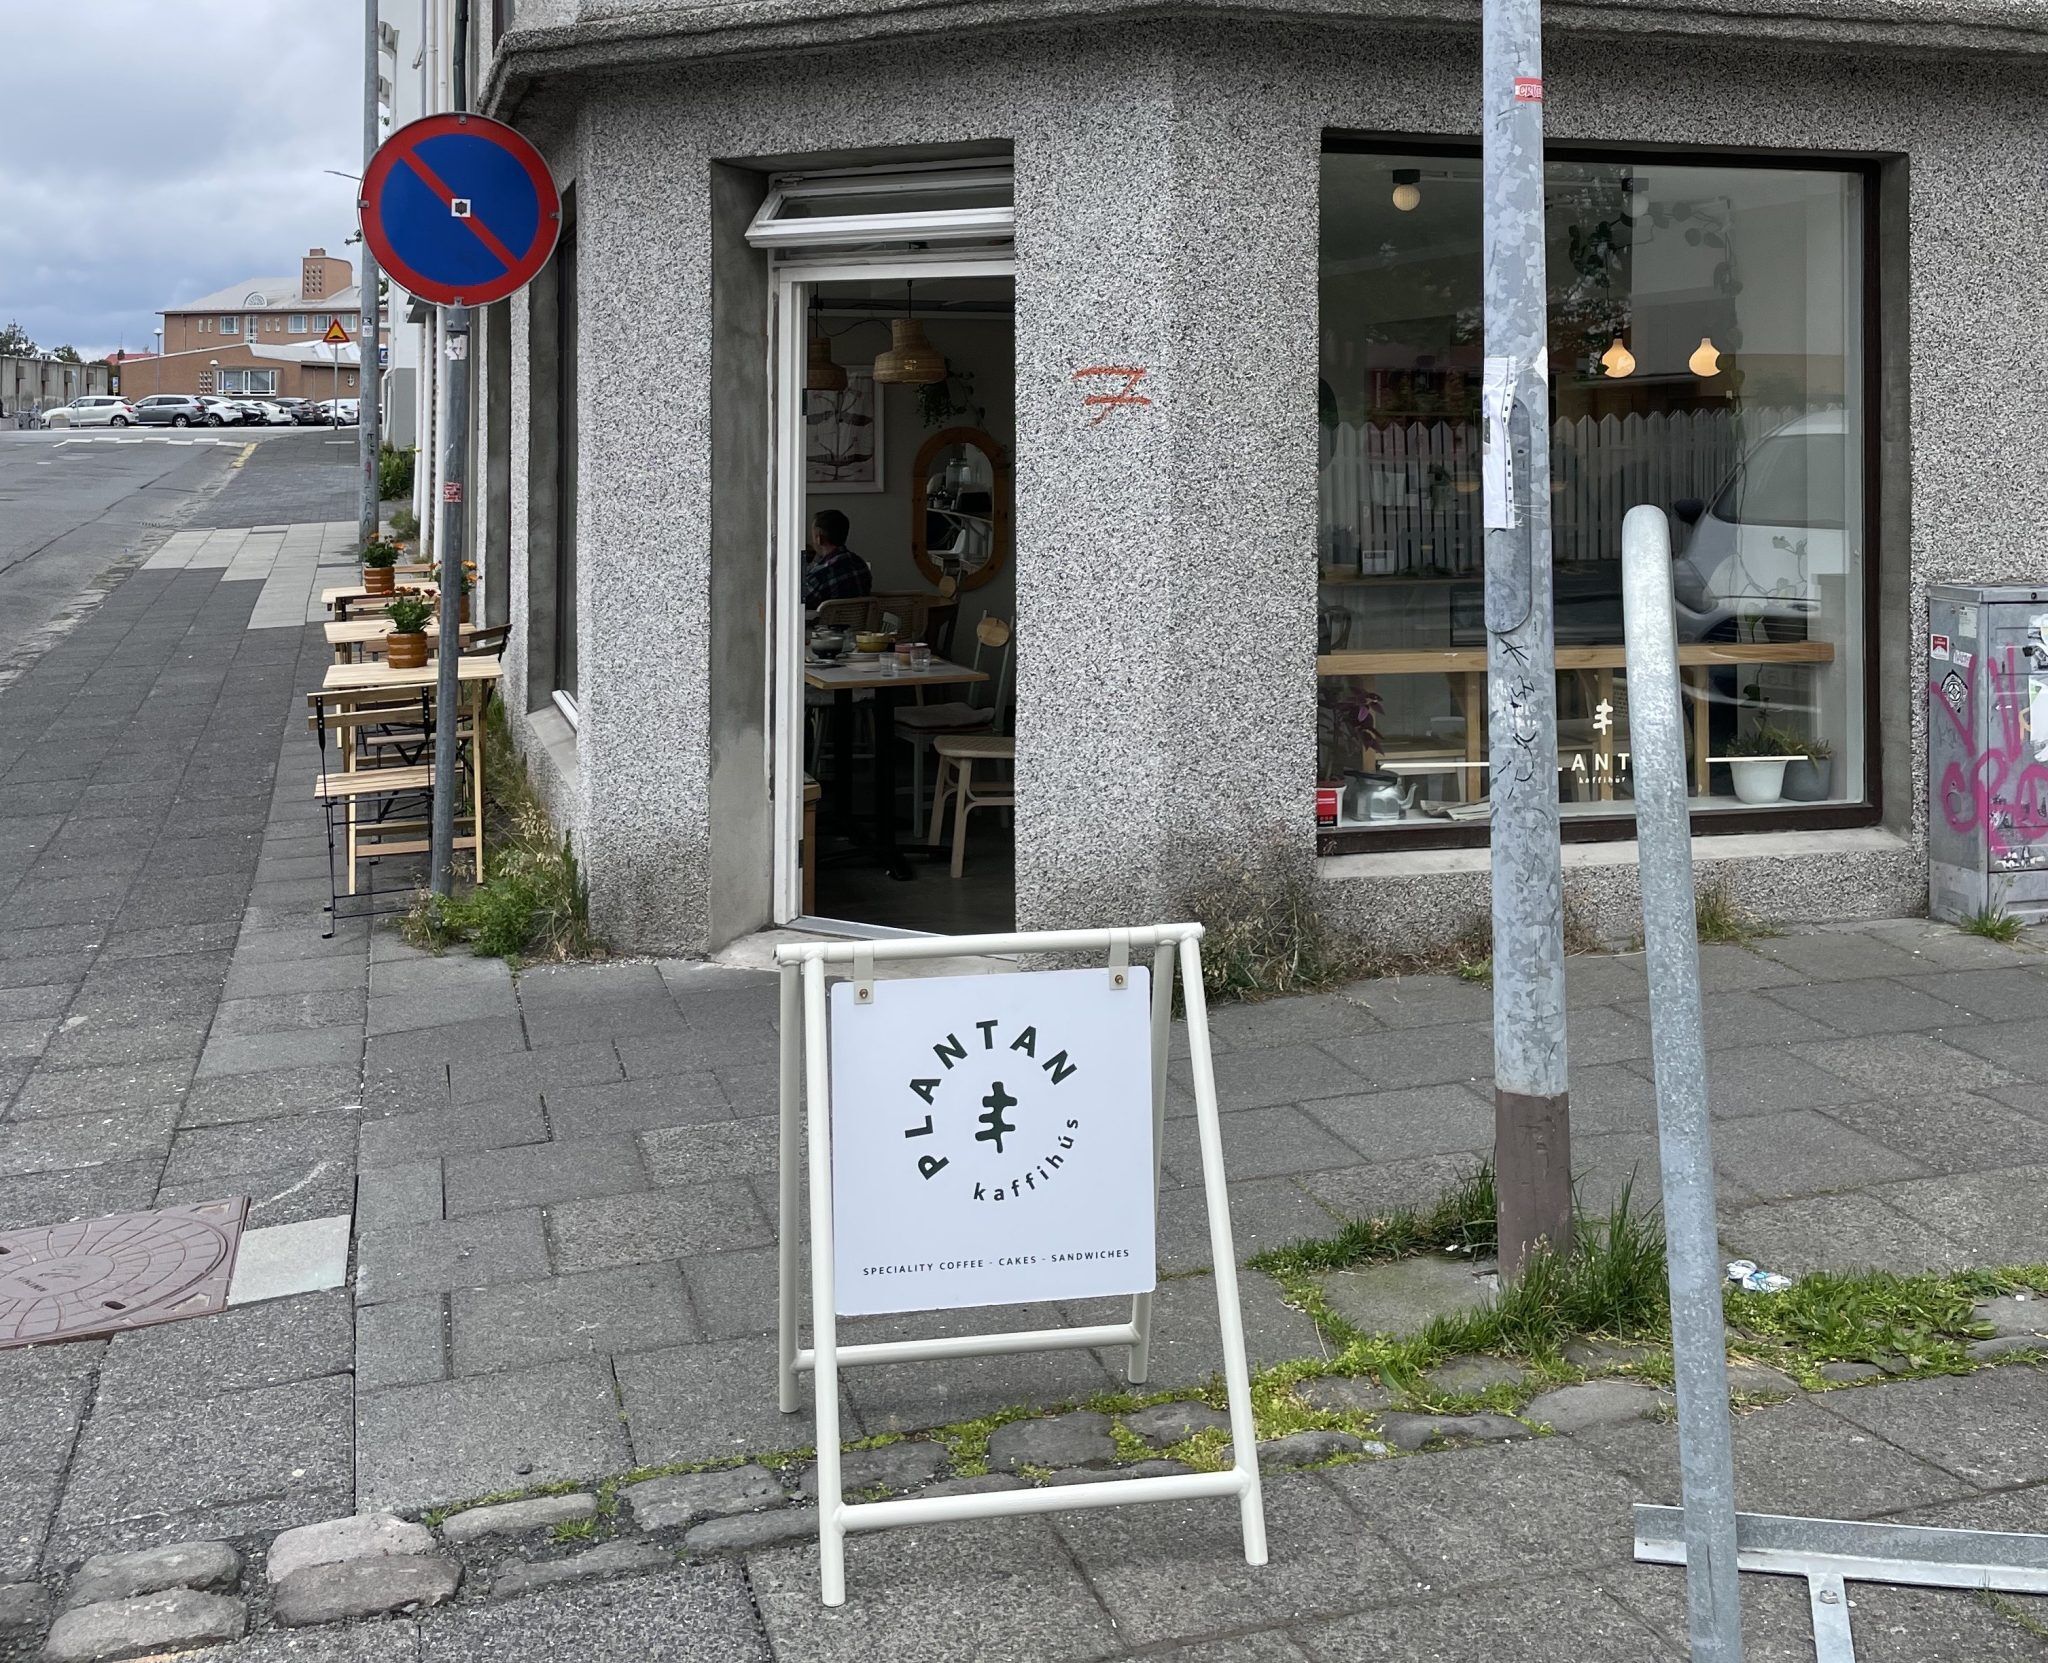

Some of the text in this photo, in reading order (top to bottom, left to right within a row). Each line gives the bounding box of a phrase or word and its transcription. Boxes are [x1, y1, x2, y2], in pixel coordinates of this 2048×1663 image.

[904, 1019, 1079, 1180] PLANTAN
[973, 1118, 1079, 1201] kaffihús
[863, 1263, 934, 1276] SPECIALITY
[939, 1259, 984, 1271] COFFEE
[998, 1255, 1037, 1267] CAKES
[1051, 1249, 1129, 1263] SANDWICHES
